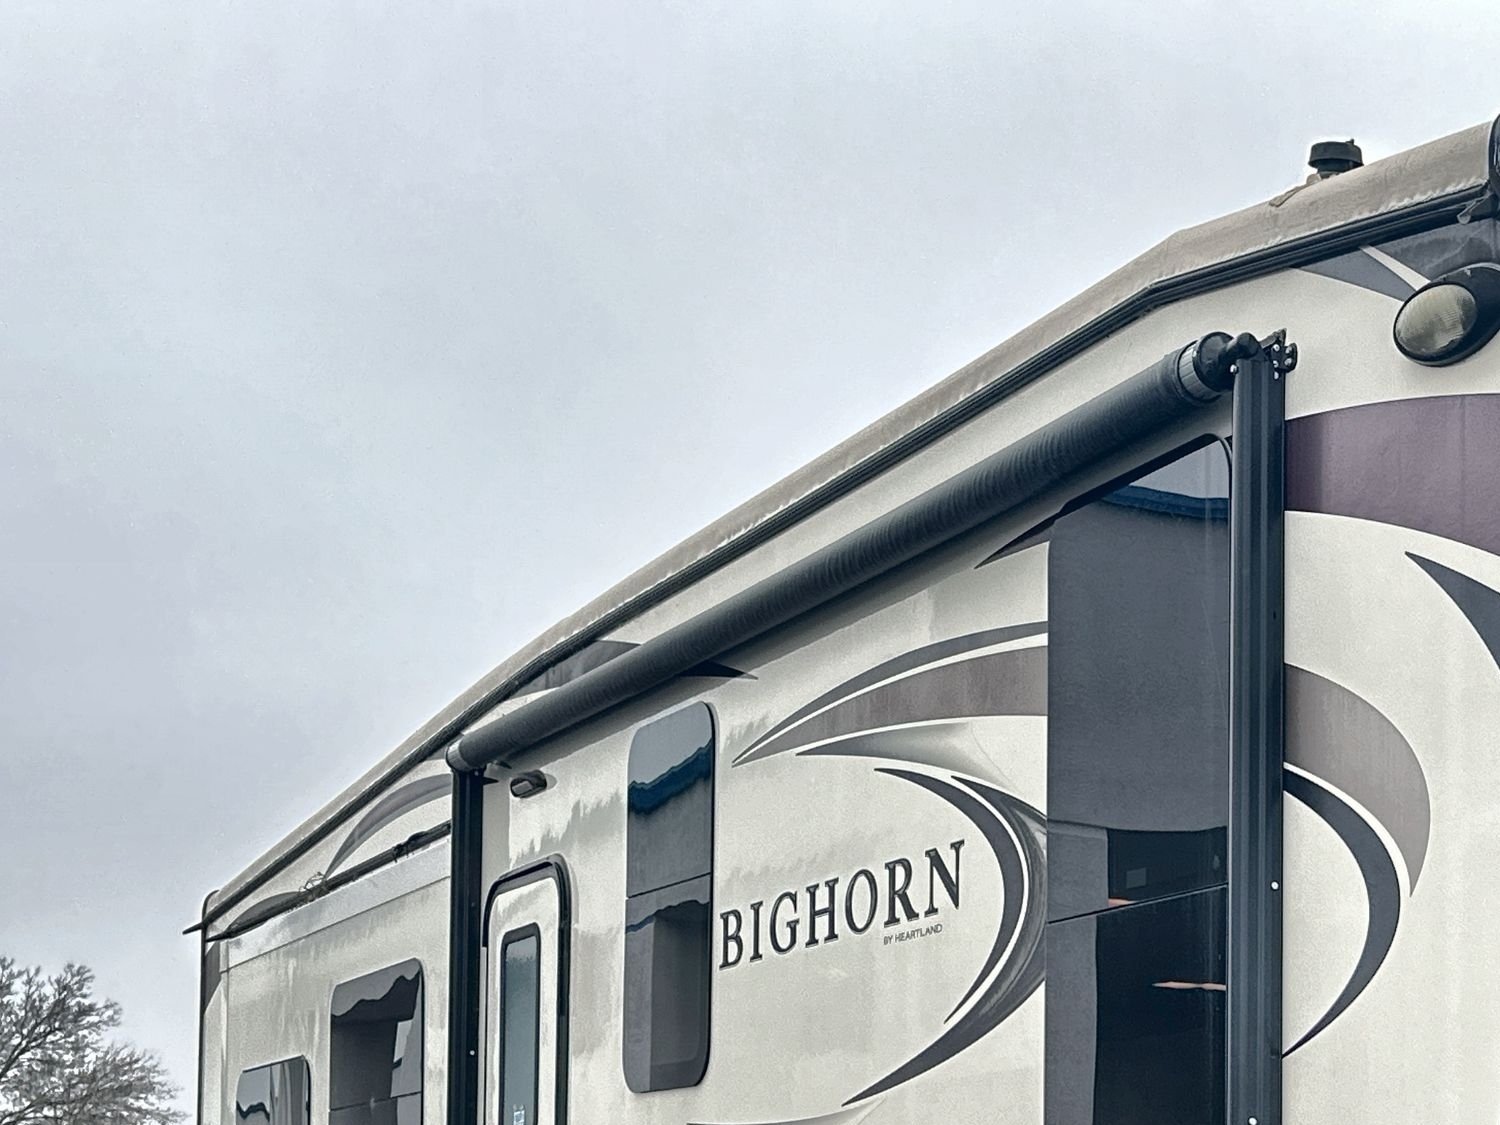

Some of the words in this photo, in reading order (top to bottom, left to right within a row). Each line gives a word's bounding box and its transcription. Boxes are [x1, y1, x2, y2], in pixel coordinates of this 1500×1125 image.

[719, 839, 965, 970] BIGHORN
[883, 934, 893, 945] BY
[894, 923, 943, 943] HEARTLAND
